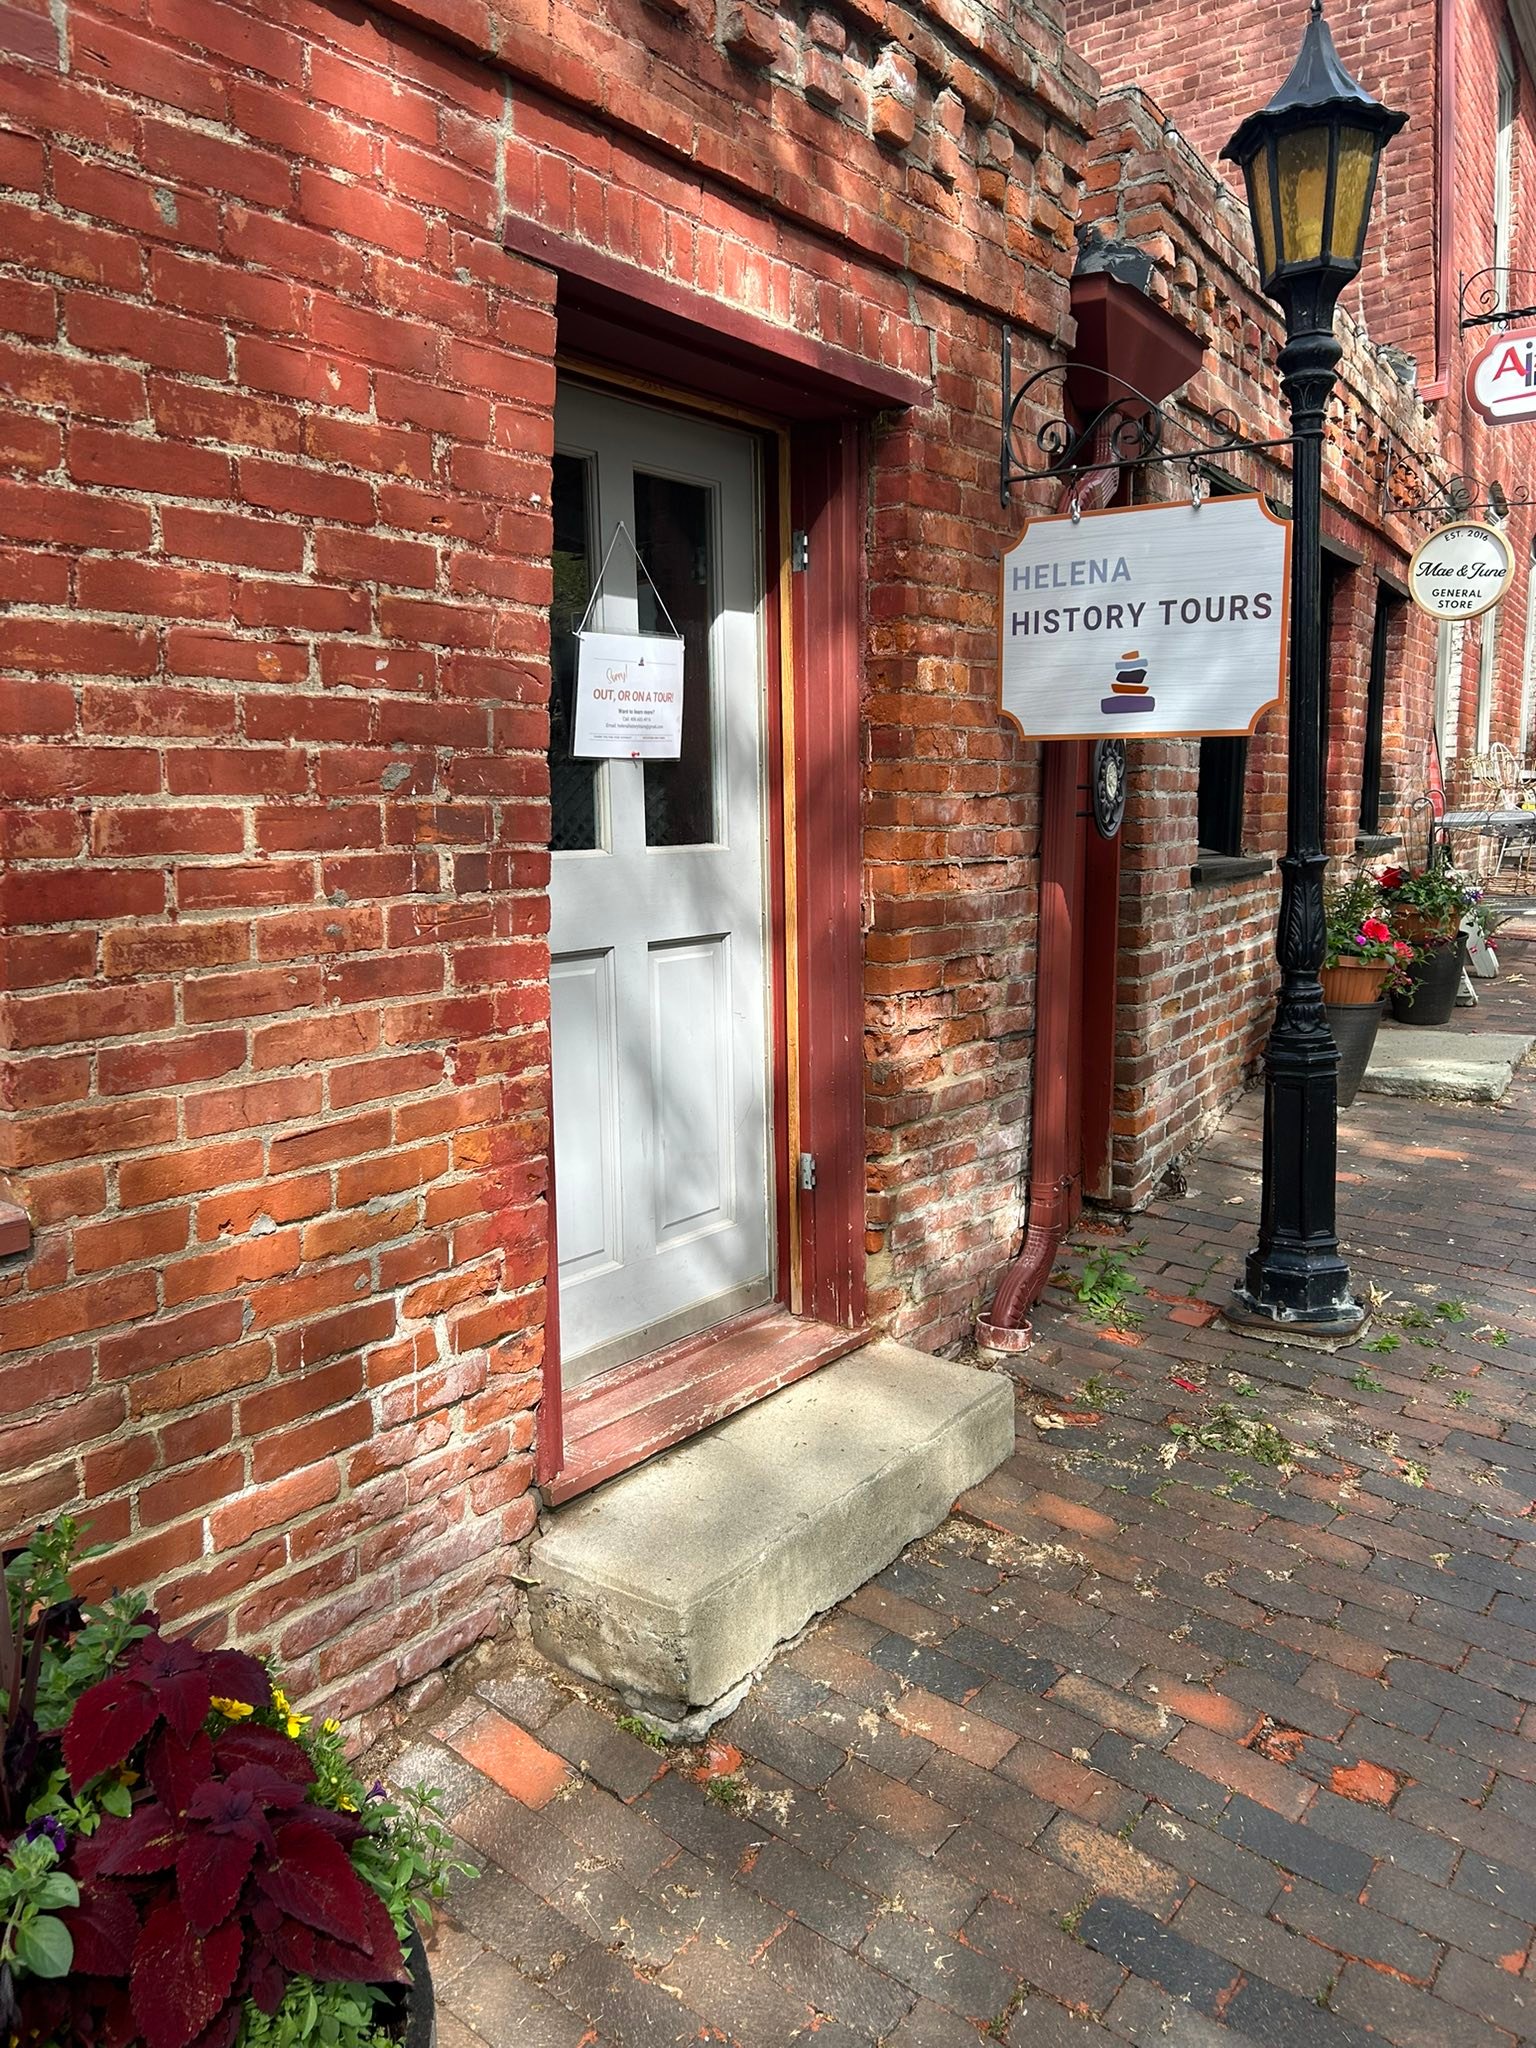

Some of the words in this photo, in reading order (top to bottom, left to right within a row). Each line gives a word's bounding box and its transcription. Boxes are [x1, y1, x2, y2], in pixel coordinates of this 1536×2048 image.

[1492, 341, 1536, 387] Ai
[1444, 530, 1464, 542] EST.
[1467, 529, 1489, 542] 2016
[1012, 556, 1131, 591] HELENA
[1416, 561, 1454, 577] Mae
[1456, 564, 1468, 577] &
[1467, 561, 1507, 580] June
[1432, 588, 1482, 598] GENERAL
[1437, 600, 1473, 609] STORE
[1011, 601, 1146, 636] HISTORY
[1158, 592, 1273, 626] TOURS
[593, 688, 616, 702] OUT,
[618, 690, 630, 701] OR
[632, 690, 645, 702] ON
[645, 691, 652, 702] A
[653, 691, 674, 703] TOUR!
